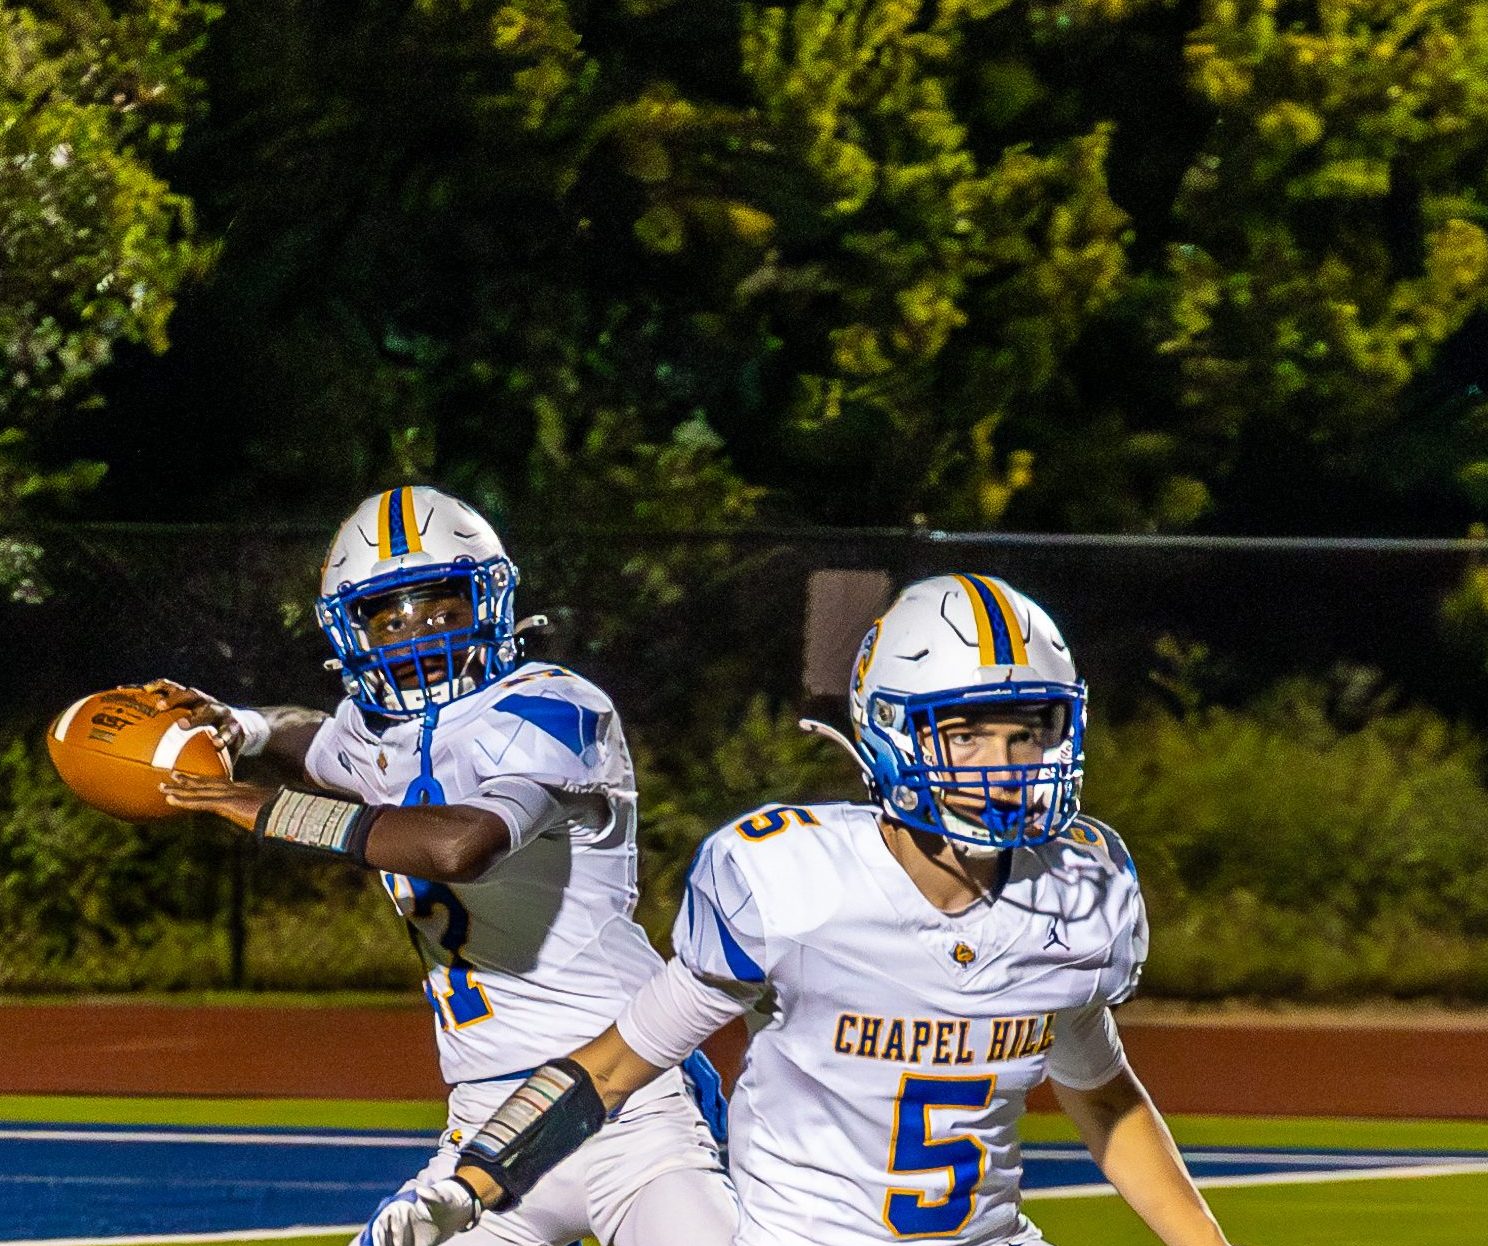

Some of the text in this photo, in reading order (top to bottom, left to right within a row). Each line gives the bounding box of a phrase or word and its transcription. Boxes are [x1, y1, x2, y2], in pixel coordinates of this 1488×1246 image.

[735, 806, 822, 843] 5
[833, 1011, 1056, 1065] CHAPEL HILL
[881, 1071, 998, 1239] 5
